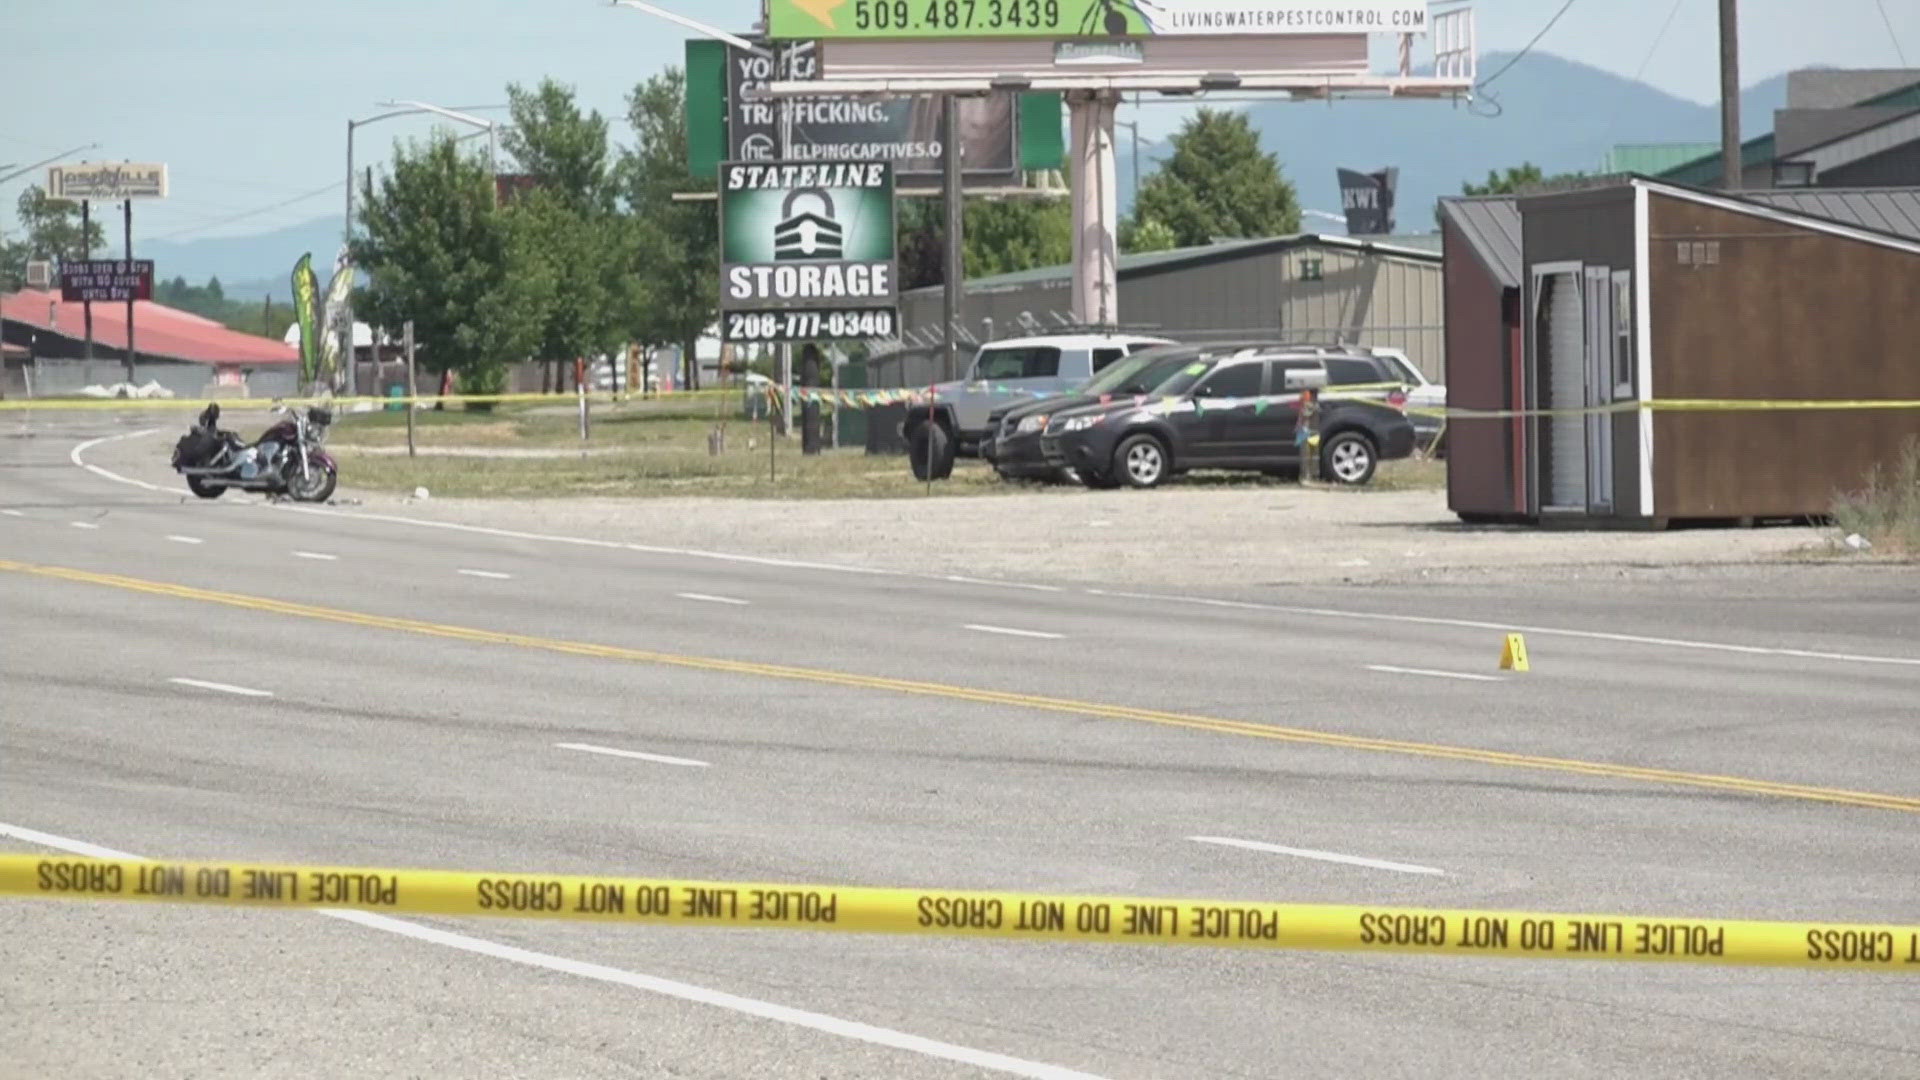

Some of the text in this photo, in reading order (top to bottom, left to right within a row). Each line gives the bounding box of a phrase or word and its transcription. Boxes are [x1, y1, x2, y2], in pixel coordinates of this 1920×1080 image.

[855, 0, 1059, 29] 509.487.3439
[738, 57, 785, 79] YO
[739, 102, 890, 124] TRAFICKING.
[728, 163, 885, 189] STATELINE
[729, 264, 889, 299] STORAGE
[728, 310, 892, 340] 208-777-0340
[37, 861, 397, 905] POLICE LINE DO NOT CROSS
[478, 879, 837, 923] POLICE LINE DO NOT CROSS
[918, 896, 1278, 941] POLICE LINE DO NOT CROSS
[1359, 912, 1724, 957] POLICE LINE DO NOT CROSS
[1807, 929, 1893, 963] CROSS
